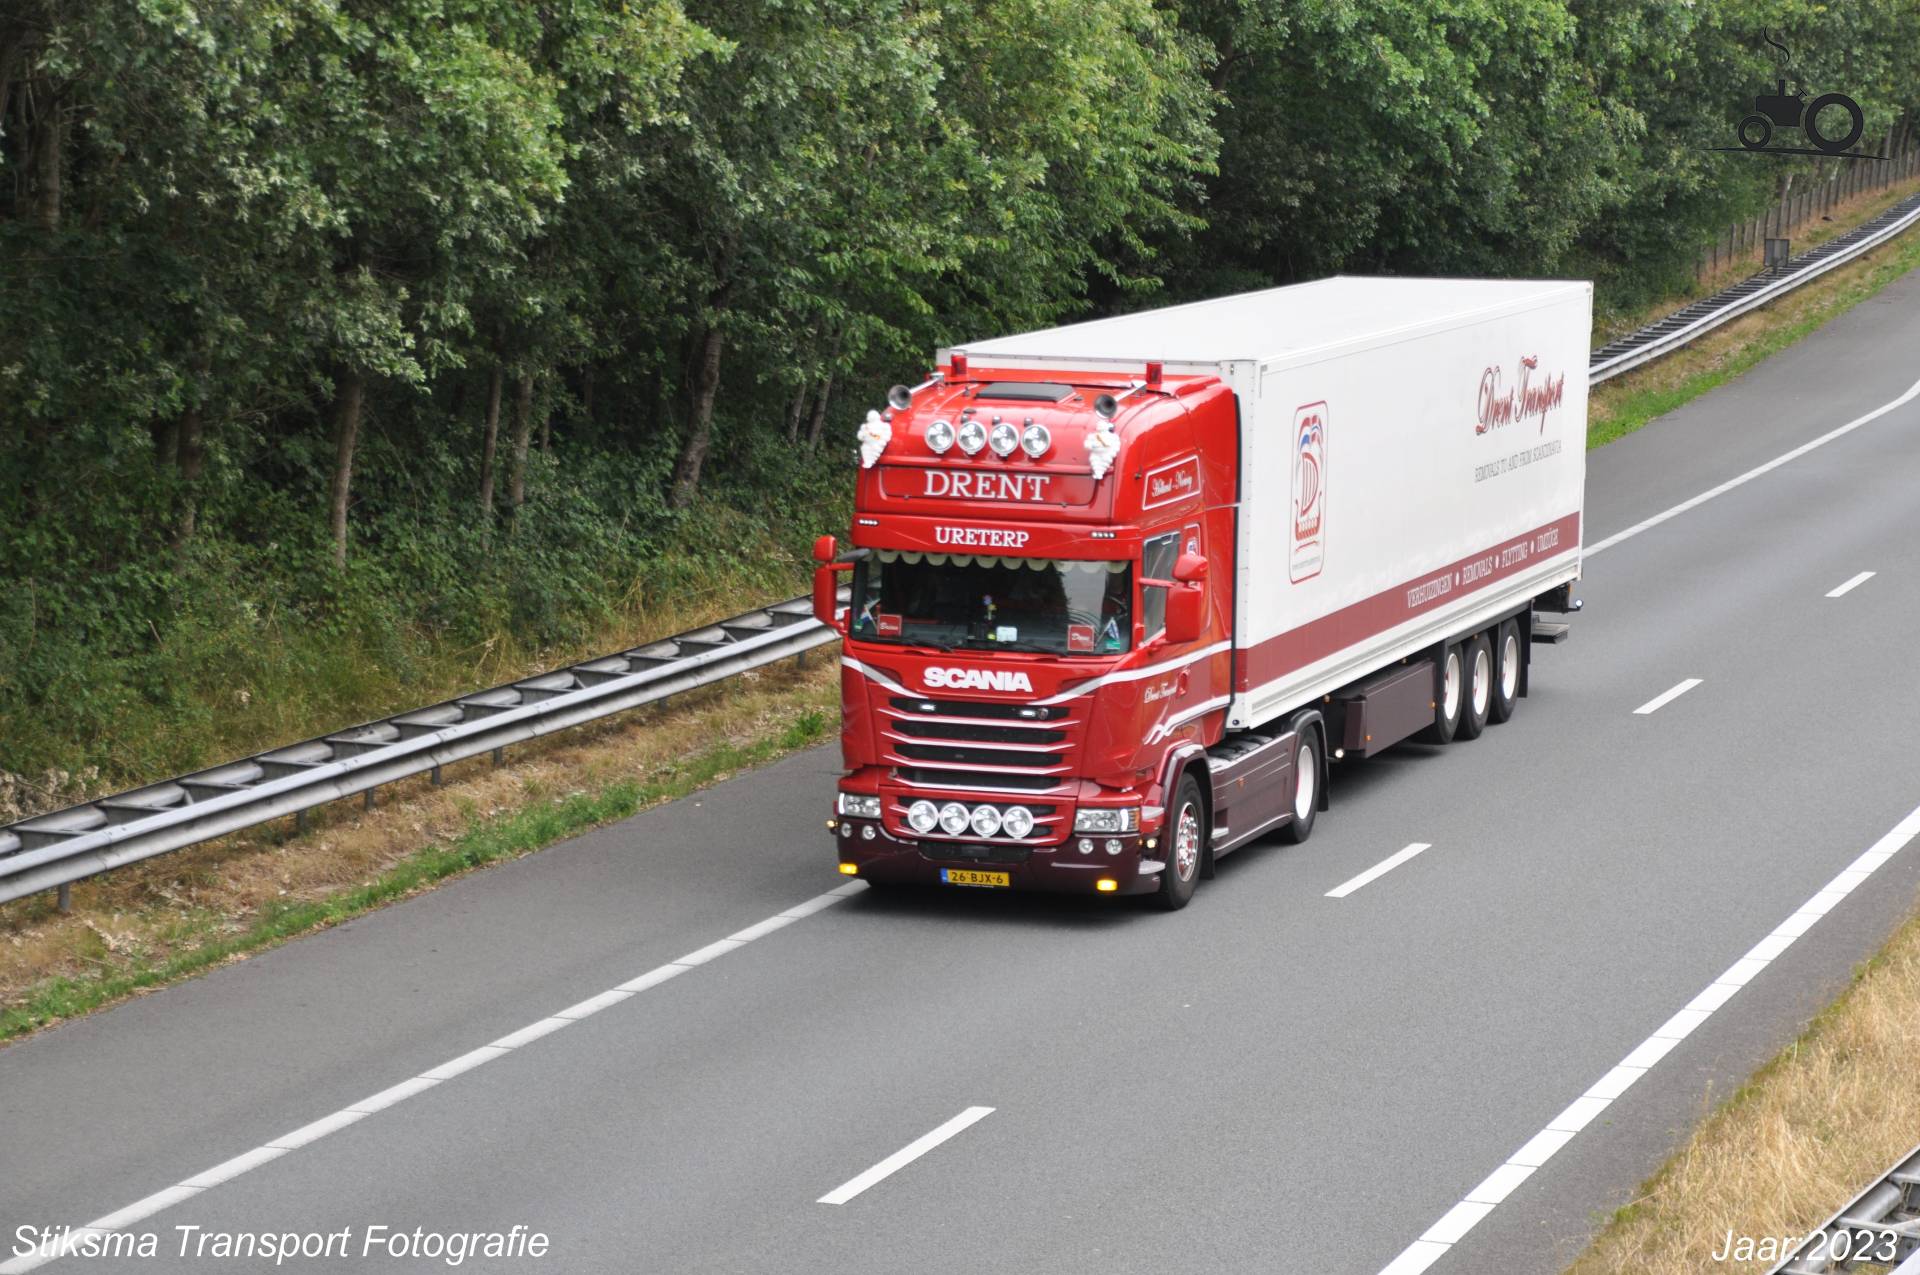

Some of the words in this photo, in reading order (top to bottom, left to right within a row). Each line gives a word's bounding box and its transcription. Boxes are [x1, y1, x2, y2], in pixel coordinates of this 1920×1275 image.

[1475, 365, 1515, 435] Drent
[924, 470, 1050, 500] DRENT
[934, 526, 1030, 548] URETERP
[1407, 573, 1453, 608] VERHUIZINGEN
[1463, 556, 1493, 586] REMOVALS
[1501, 542, 1528, 568] FLYTTING
[923, 666, 1033, 692] SCANIA
